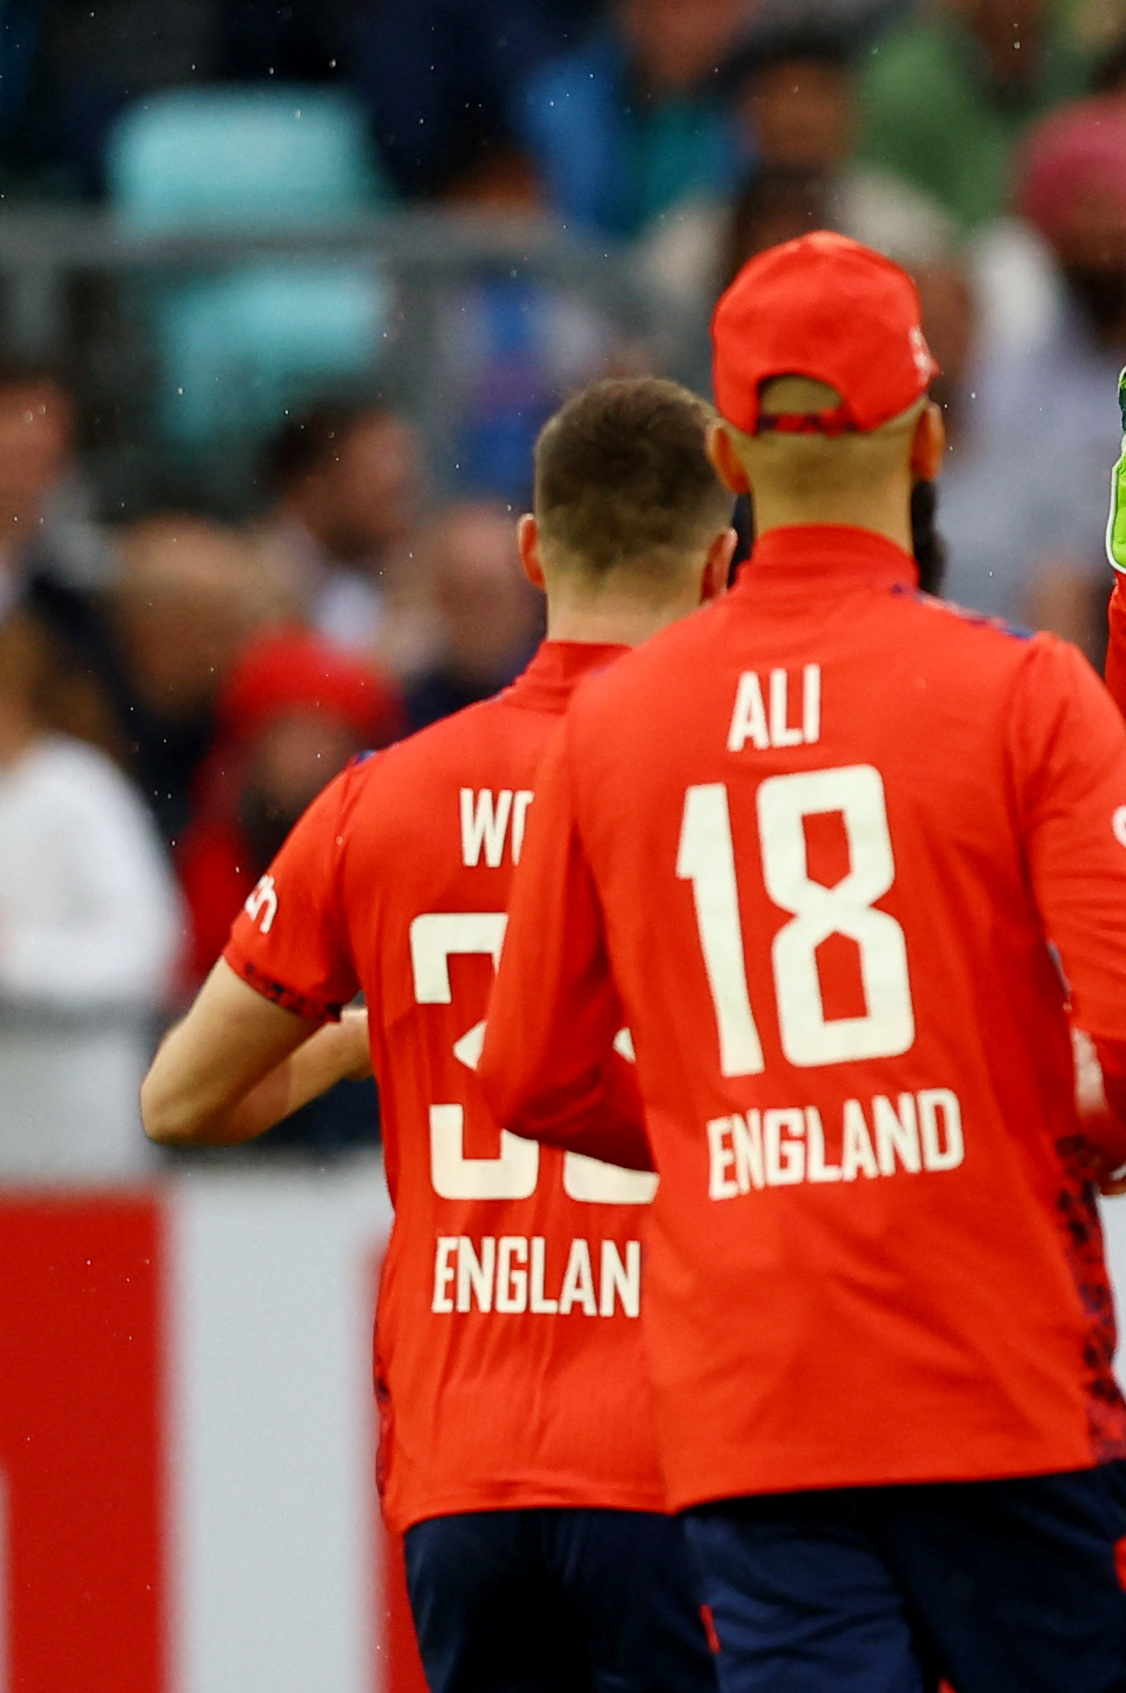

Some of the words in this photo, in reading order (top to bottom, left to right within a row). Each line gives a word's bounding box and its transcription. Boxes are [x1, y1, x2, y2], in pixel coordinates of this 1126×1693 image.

[728, 664, 821, 752] ALI
[676, 764, 915, 1078] 18
[707, 1087, 964, 1201] ENGLAND
